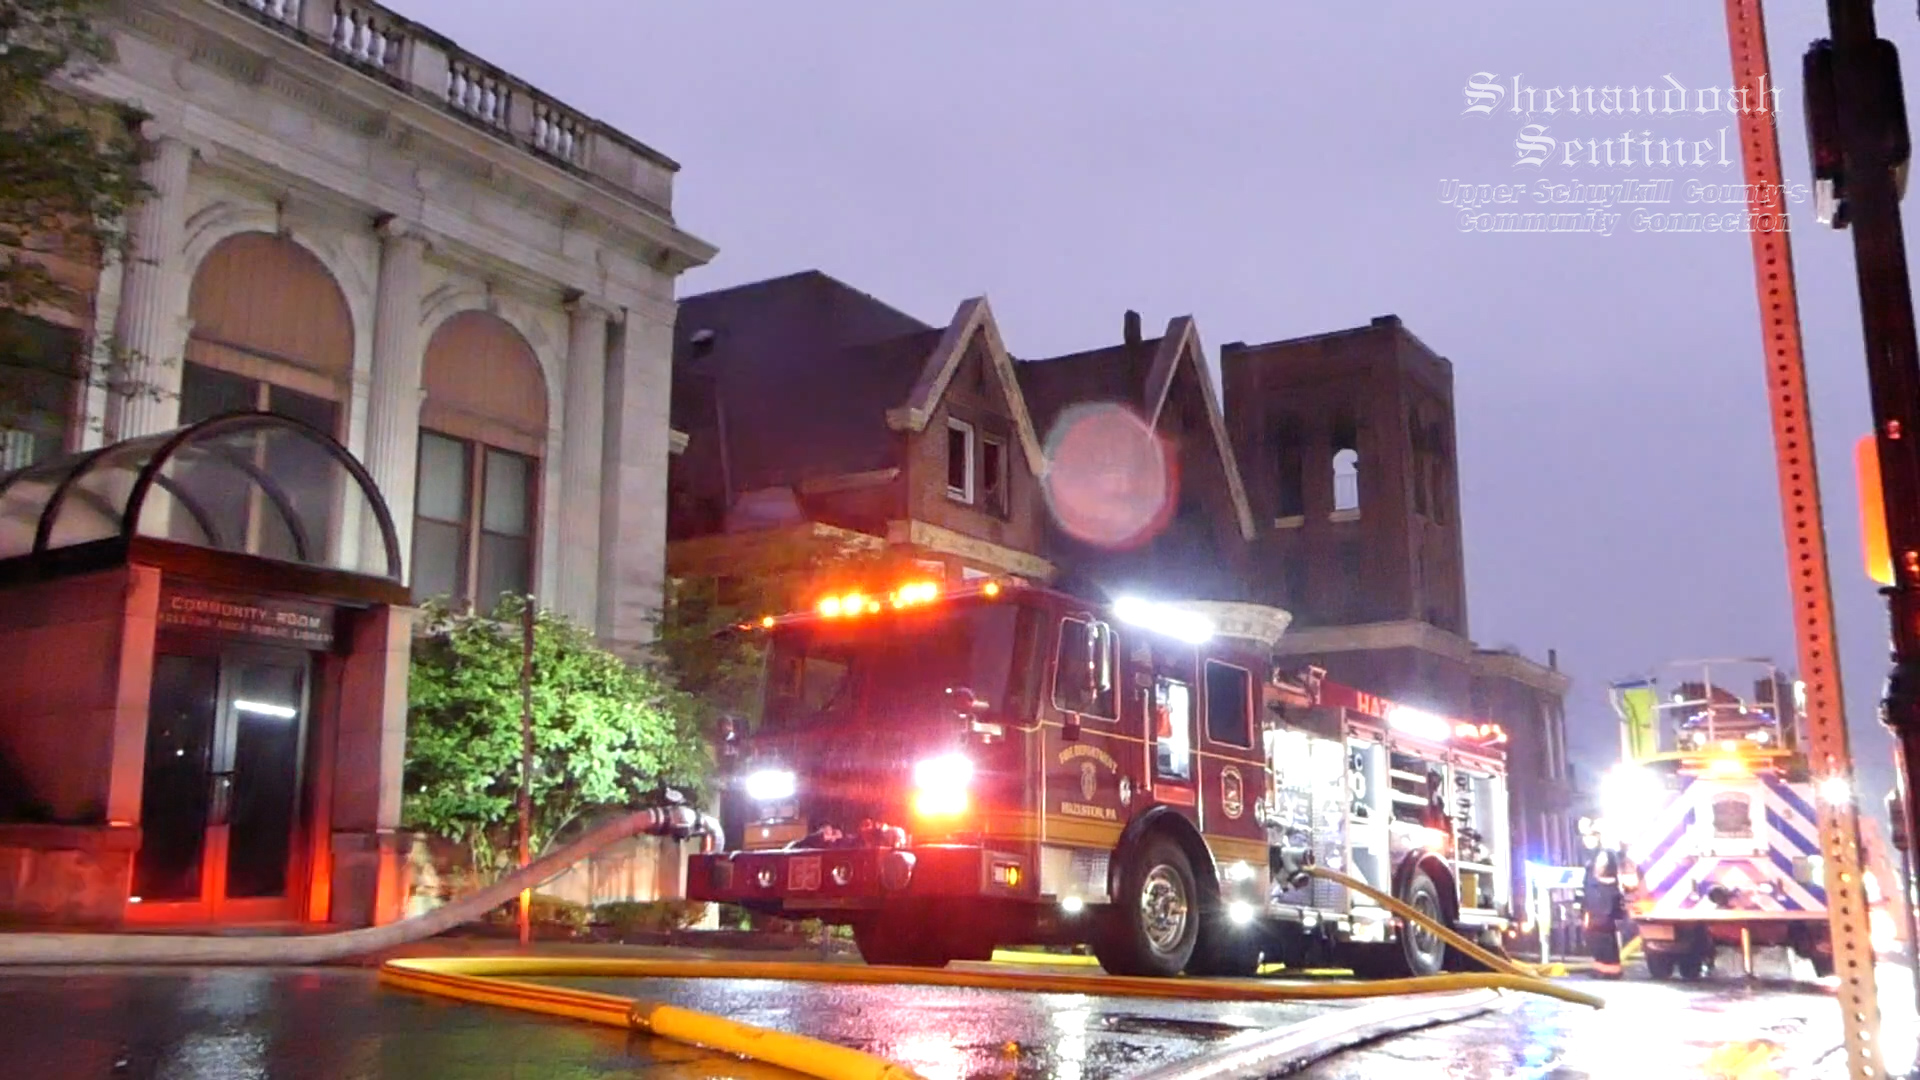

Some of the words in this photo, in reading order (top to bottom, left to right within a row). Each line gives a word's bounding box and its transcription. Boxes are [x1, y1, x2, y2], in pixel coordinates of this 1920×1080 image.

[171, 596, 267, 621] COMMUNITY
[276, 611, 321, 629] ROOM
[1105, 807, 1118, 820] PA
